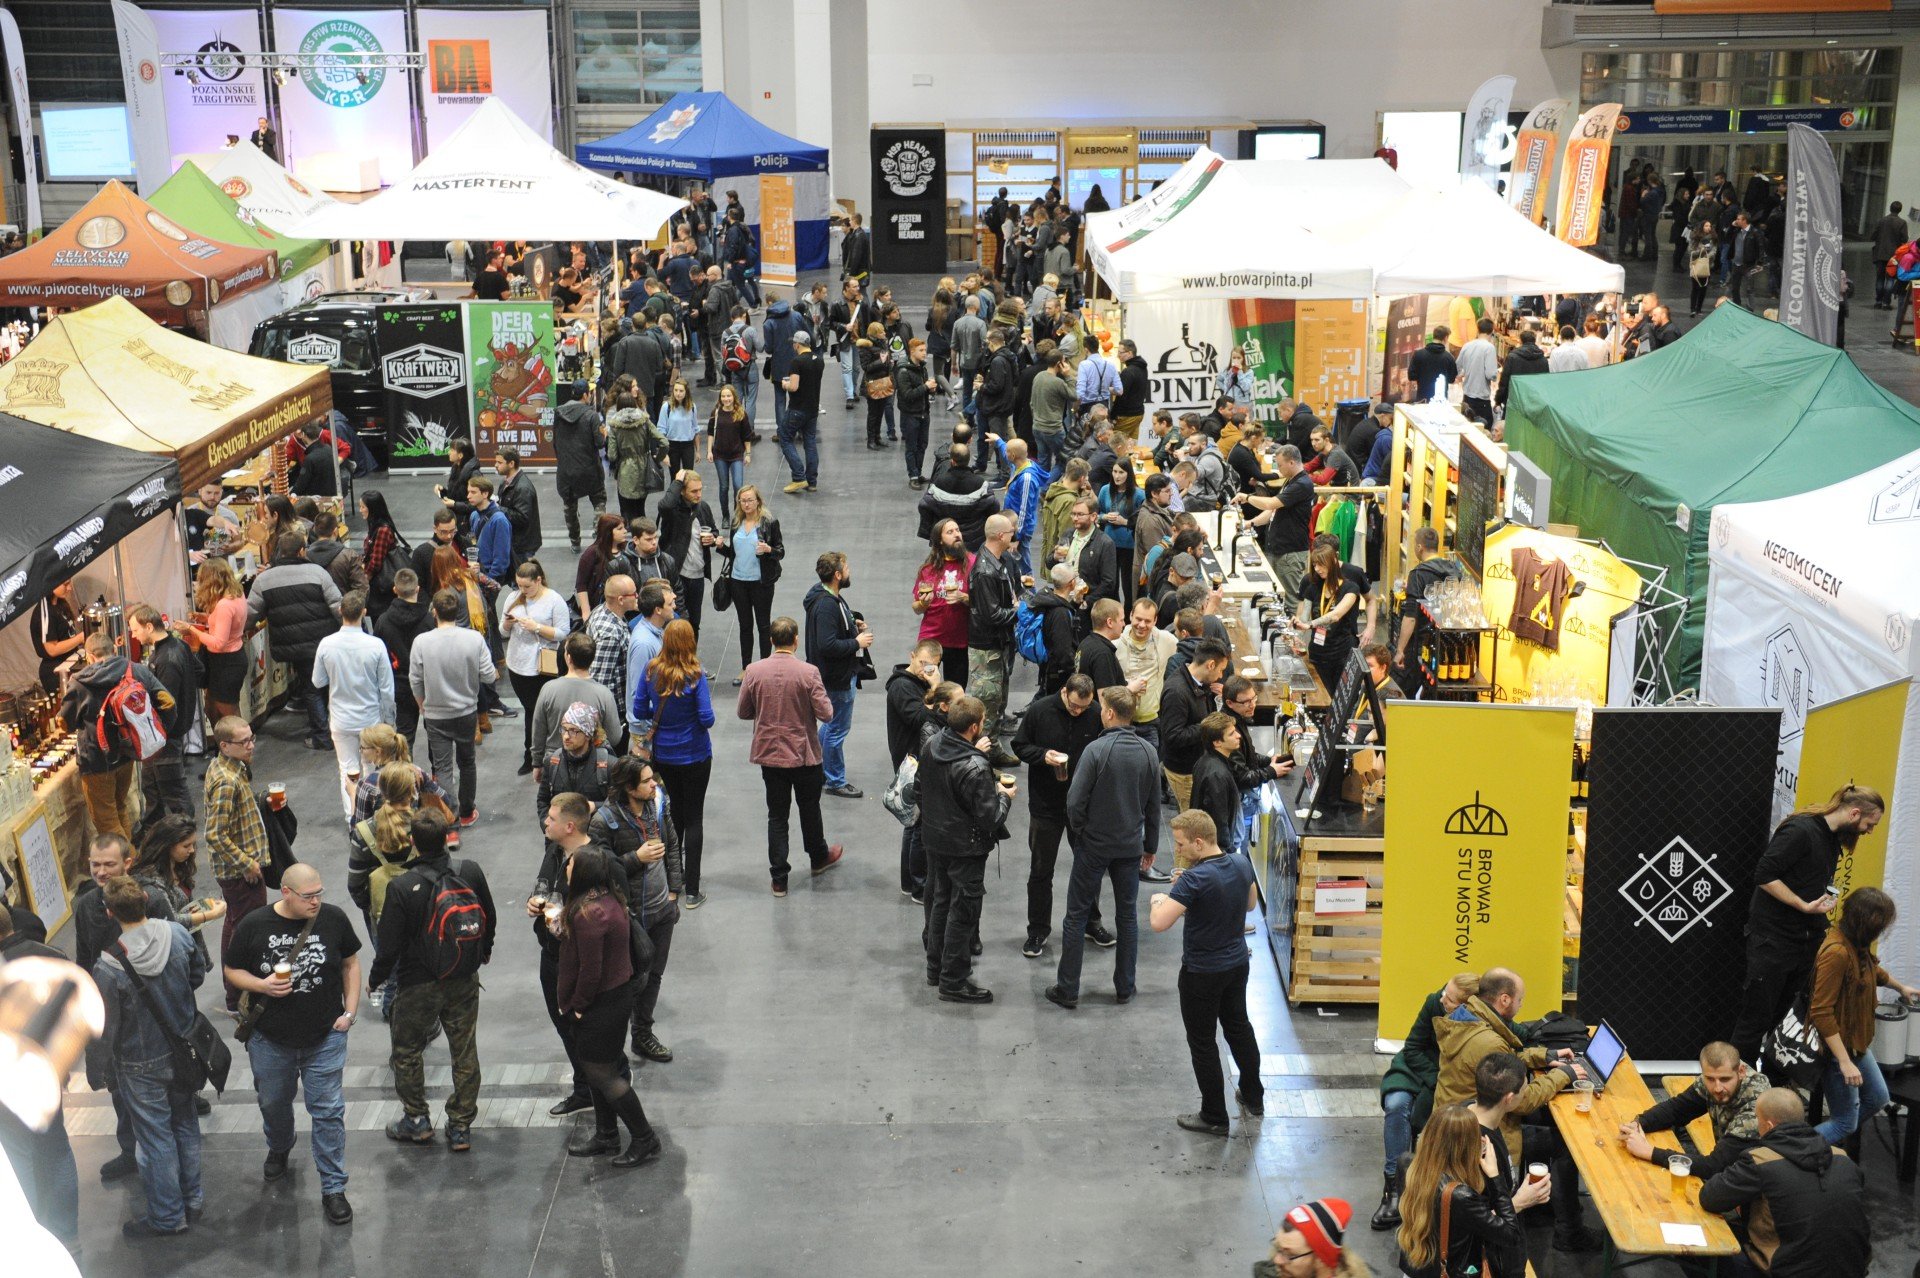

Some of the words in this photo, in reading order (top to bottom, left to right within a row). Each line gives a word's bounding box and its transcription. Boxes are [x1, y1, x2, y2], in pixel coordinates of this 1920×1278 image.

[435, 45, 479, 93] BA
[191, 95, 221, 103] TARGI
[223, 95, 257, 103] PIWNE
[1676, 114, 1713, 122] wschodnie
[1785, 112, 1822, 120] wschodnie
[886, 142, 902, 159] HOP
[903, 140, 930, 158] HEADS
[1073, 146, 1129, 155] ALEBROWAR
[589, 153, 615, 163] Komenda
[753, 154, 789, 168] Policja
[412, 178, 536, 191] MASTERTENT
[1571, 147, 1596, 241] CHMIELARIUM
[56, 250, 130, 259] CELTYCKIE
[1182, 272, 1313, 289] www.browarpinta.pl
[7, 283, 146, 298] www.piwoceltyckie.pl
[491, 311, 533, 332] DEER
[291, 344, 337, 356] KRAFTWERK
[388, 360, 459, 379] KRAFTWERK
[208, 431, 248, 468] Browar
[249, 395, 311, 444] Rzemieślniczy
[497, 431, 518, 443] RYE
[521, 431, 537, 443] IPA
[1763, 540, 1843, 598] NEPOMUCEN
[1457, 848, 1472, 881] STU
[1476, 849, 1492, 924] BROWAR
[1455, 886, 1473, 964] MOSTÓW
